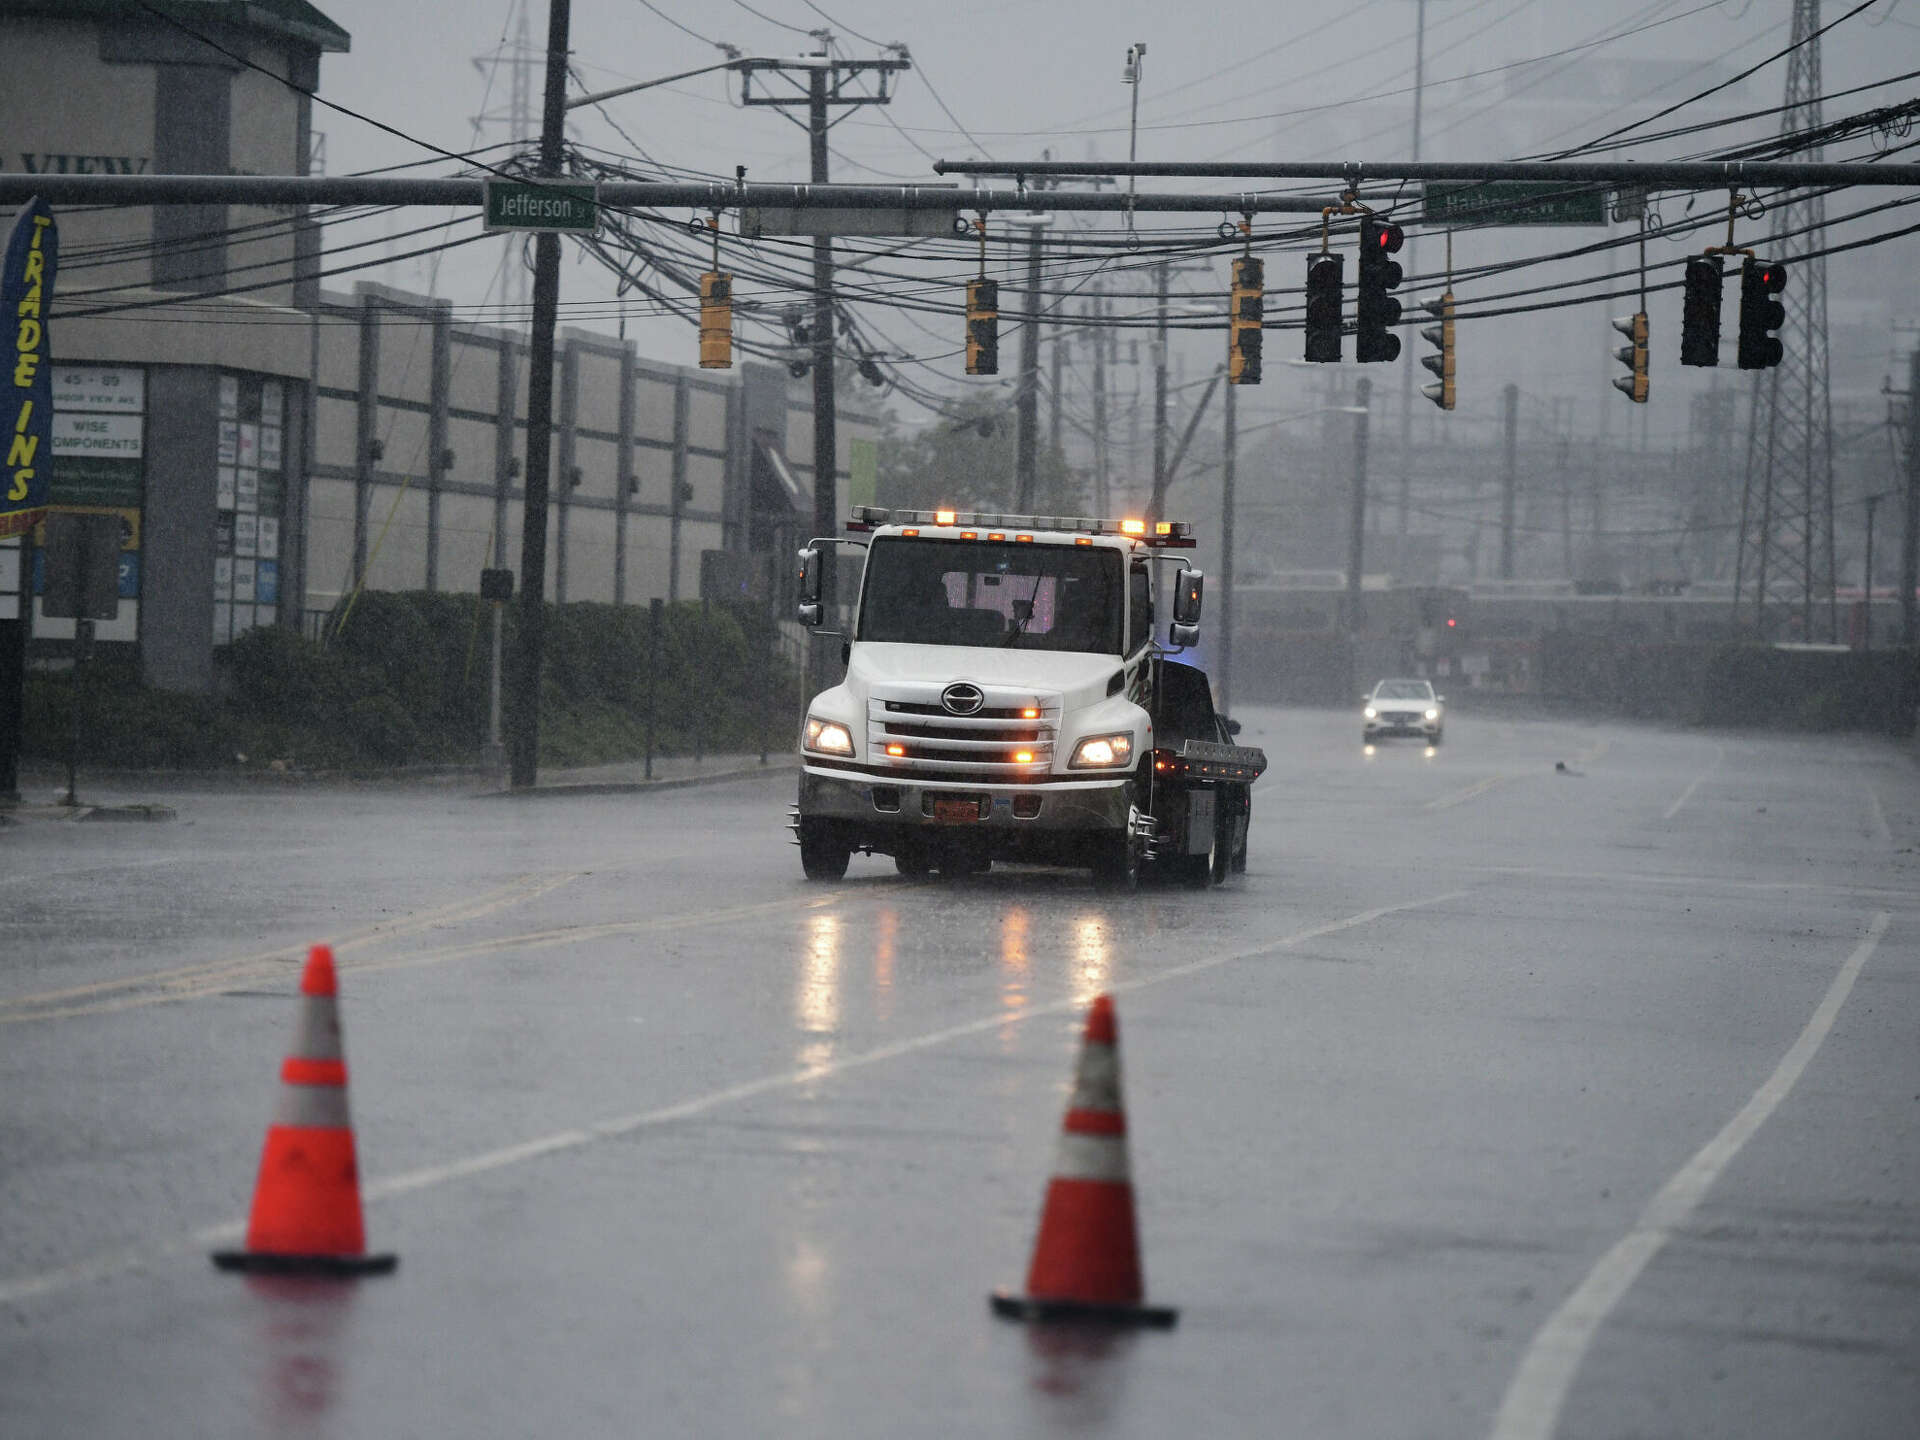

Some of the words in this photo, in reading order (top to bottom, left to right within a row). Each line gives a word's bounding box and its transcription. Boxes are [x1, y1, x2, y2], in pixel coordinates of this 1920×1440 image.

[500, 194, 571, 217] Jefferson
[14, 215, 51, 388] TRADE
[73, 421, 109, 432] WISE
[7, 400, 38, 501] INS
[53, 436, 139, 451] OMPONENTS
